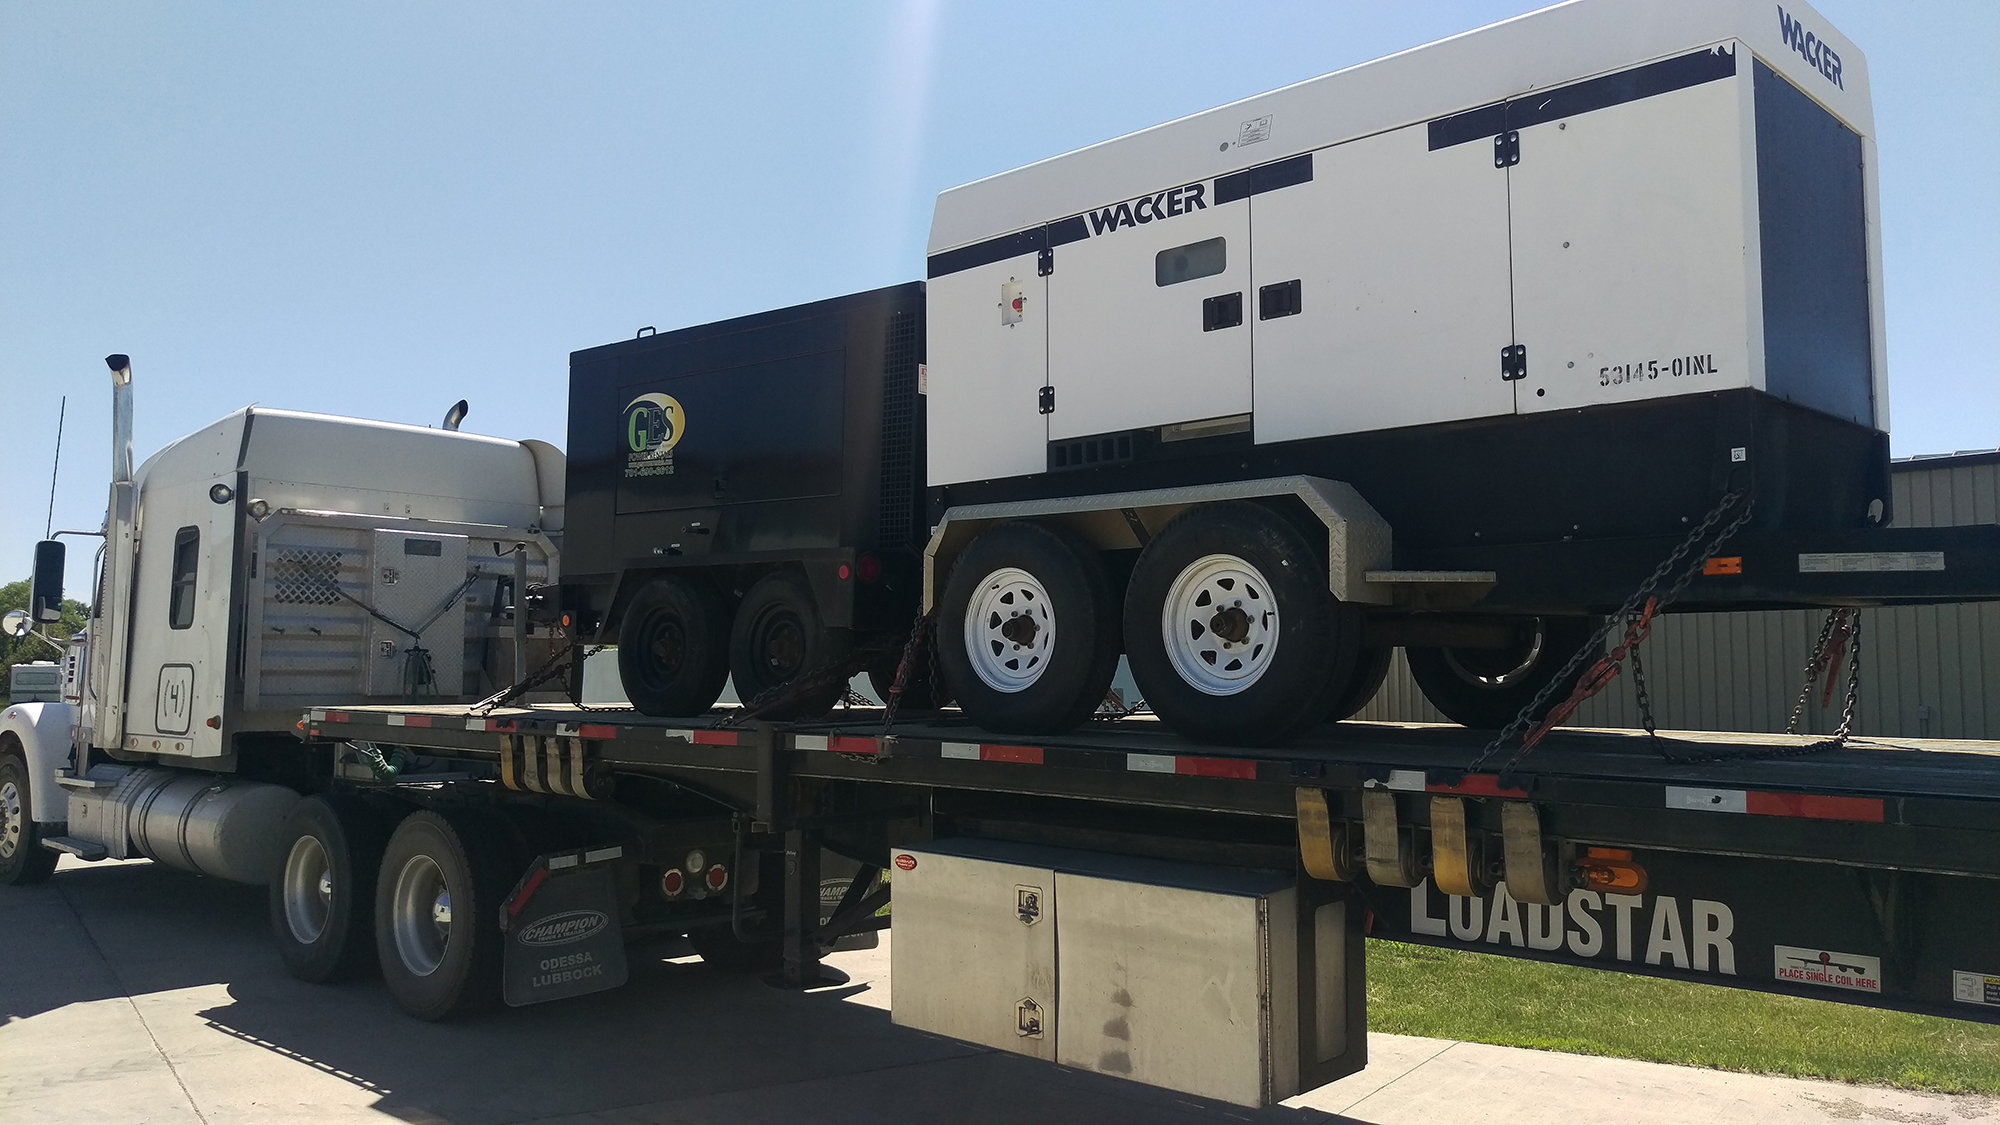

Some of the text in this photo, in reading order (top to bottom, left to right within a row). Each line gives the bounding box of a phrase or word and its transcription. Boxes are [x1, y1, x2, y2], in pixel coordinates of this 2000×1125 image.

[1776, 4, 1844, 92] WACKER
[1089, 183, 1207, 236] WACKER
[628, 405, 674, 452] GES
[525, 915, 599, 940] CHAMPION
[538, 934, 557, 942] TRUCK
[563, 929, 586, 937] TRAILER
[540, 951, 593, 971] ODESSA
[532, 964, 603, 988] LUBBOCK
[1779, 968, 1804, 980] PLACE
[1806, 972, 1833, 984] SINGLE
[1835, 975, 1854, 986] COIL
[1856, 978, 1877, 989] HERE
